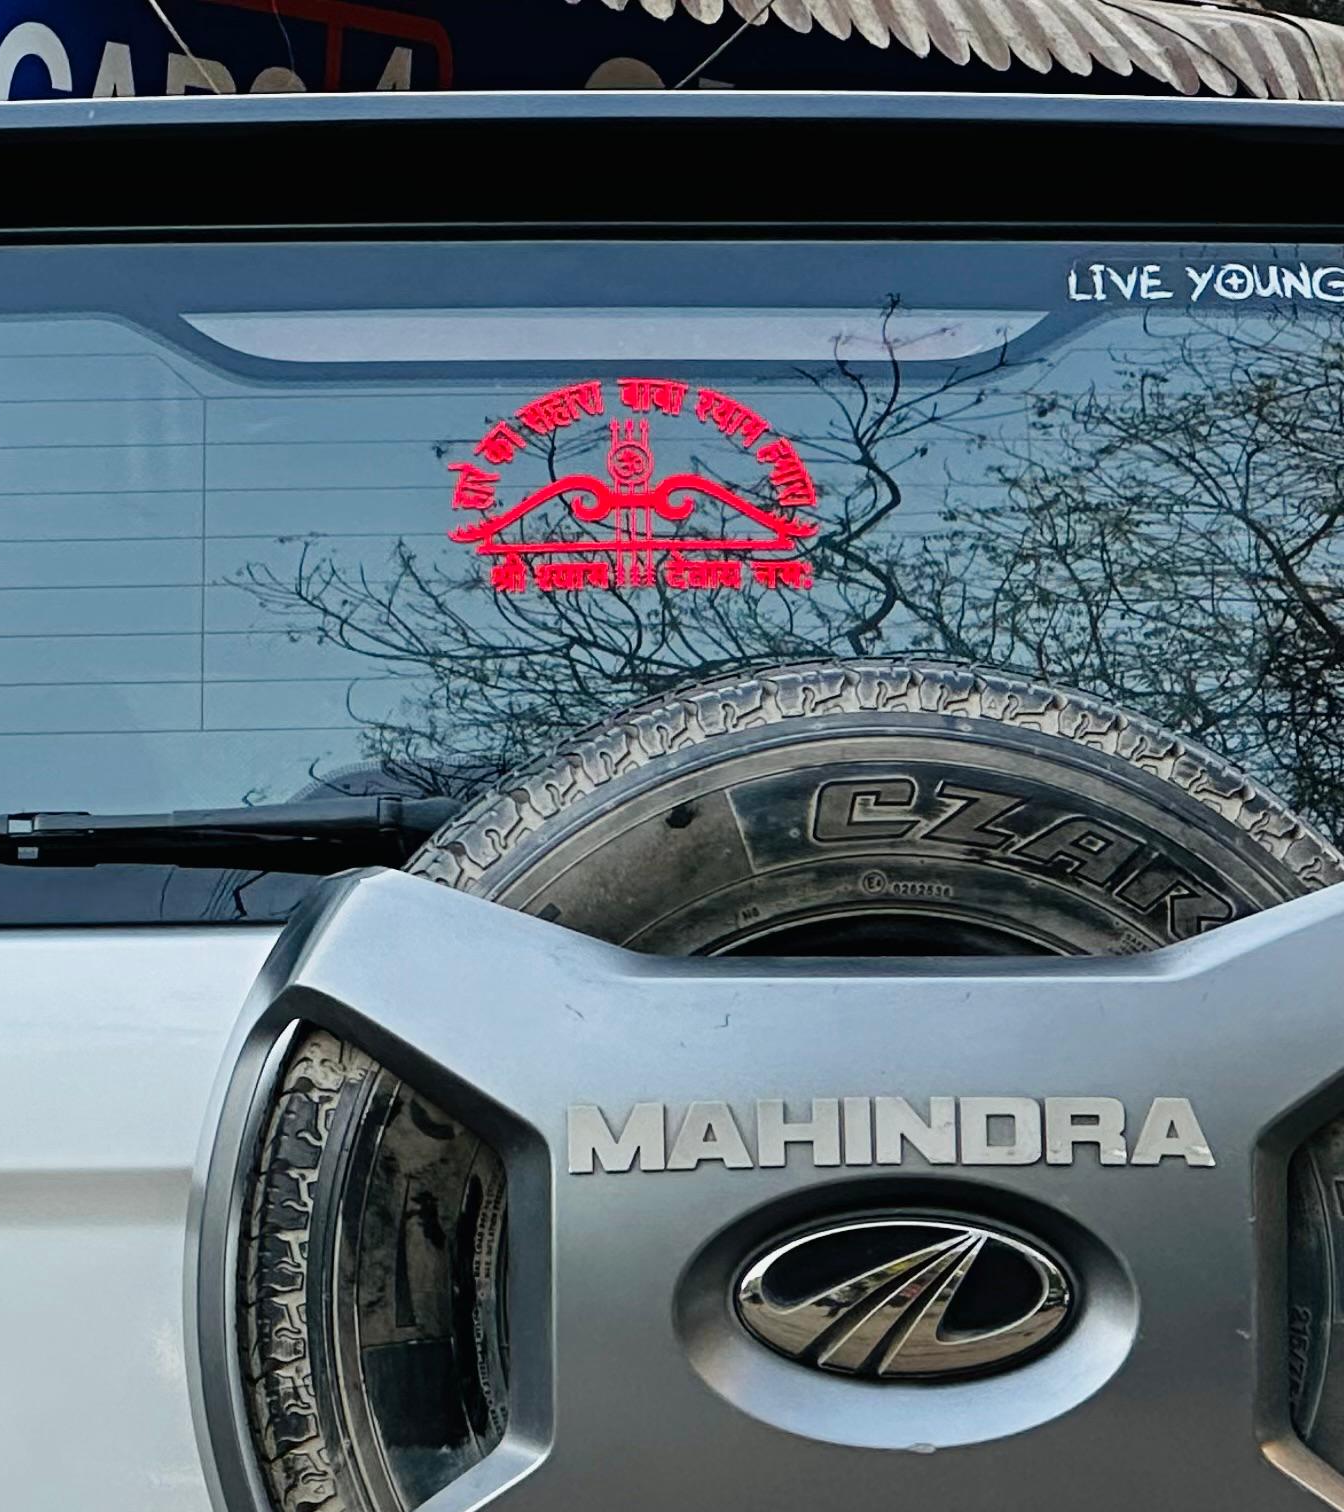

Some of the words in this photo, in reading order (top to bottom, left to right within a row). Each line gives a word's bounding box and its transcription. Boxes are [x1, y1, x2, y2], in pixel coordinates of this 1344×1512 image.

[1067, 264, 1173, 301] LIVE
[810, 775, 1236, 937] CZAR
[567, 1096, 1216, 1176] MAHINDRA
